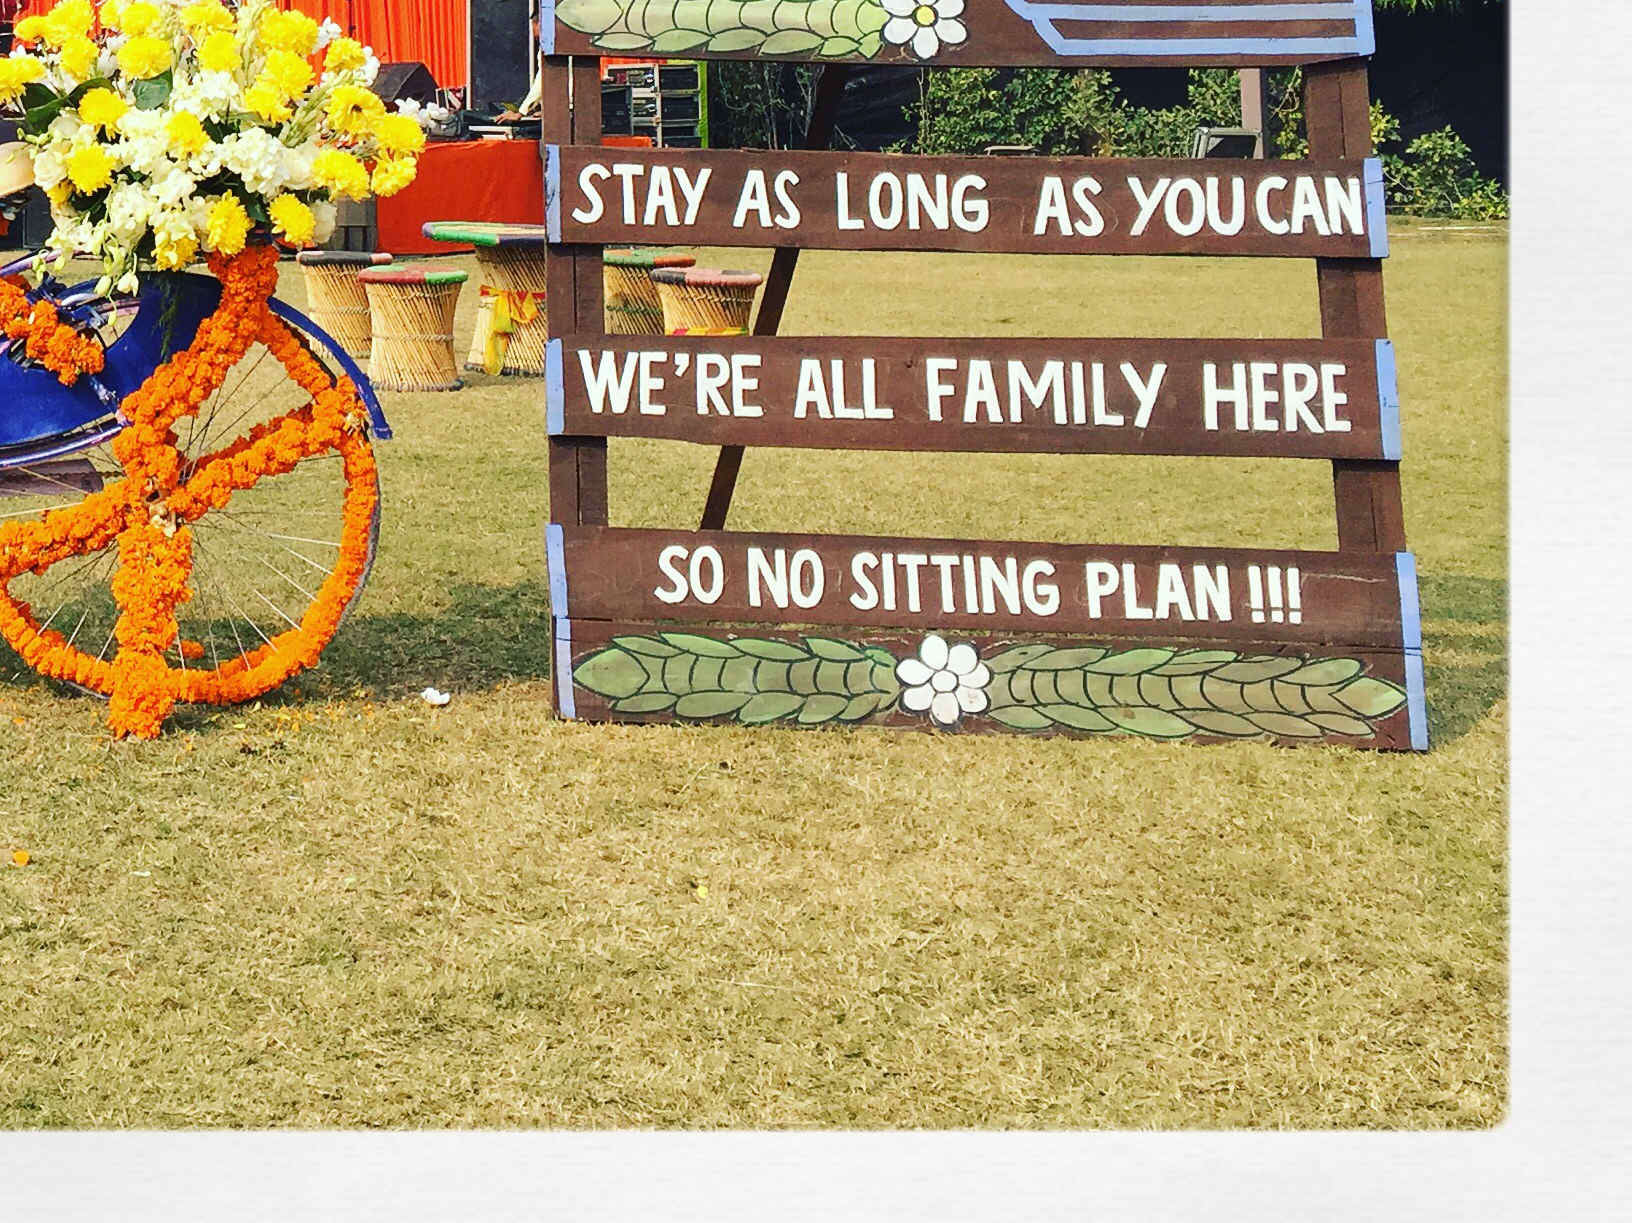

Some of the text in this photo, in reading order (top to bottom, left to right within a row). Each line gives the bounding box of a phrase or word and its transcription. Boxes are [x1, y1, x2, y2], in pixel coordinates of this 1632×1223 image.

[571, 163, 712, 226] STAY
[733, 169, 801, 229] AS
[837, 171, 990, 233] LONG
[1033, 175, 1105, 237] AS
[578, 350, 1352, 433] WE'RE ALL FAMILY HERE
[653, 544, 724, 605] SO
[747, 547, 825, 608] NO
[850, 551, 1061, 617] SITTING
[1085, 561, 1233, 623] PLAN
